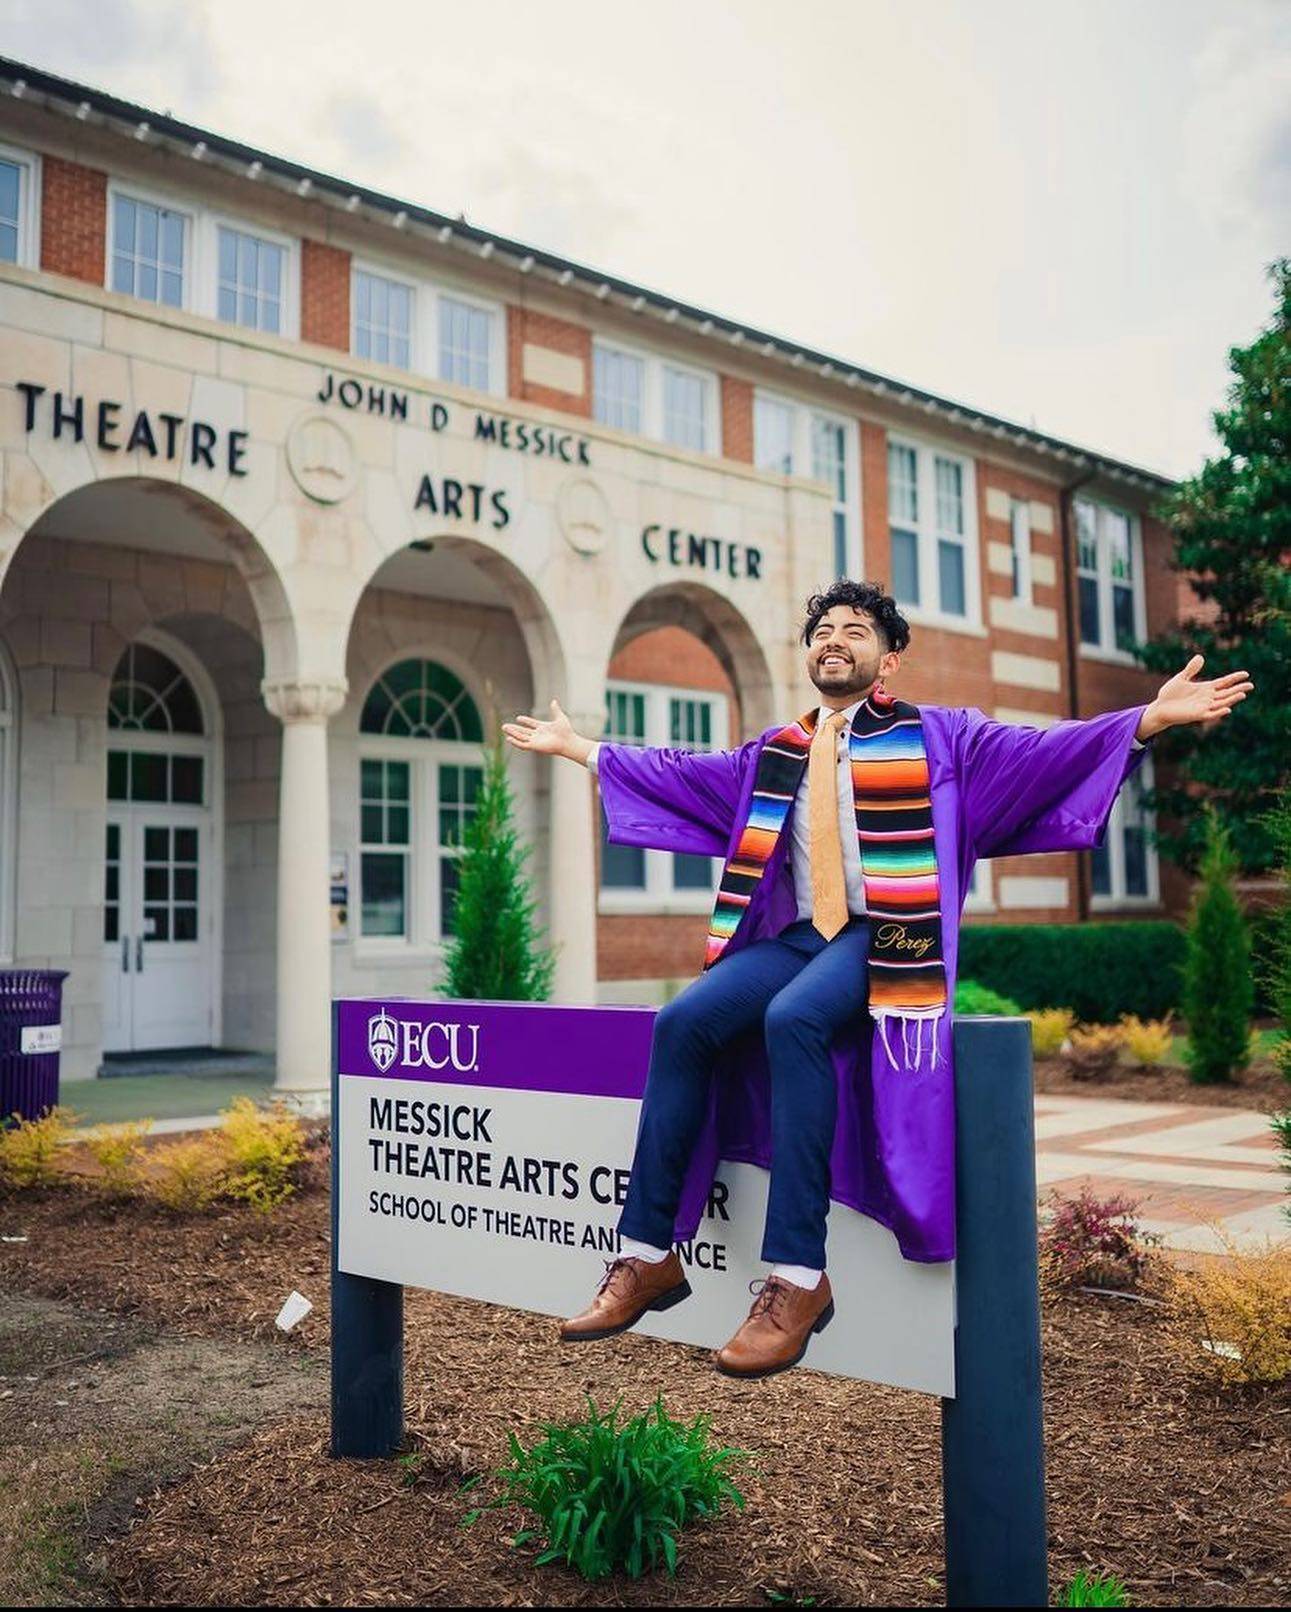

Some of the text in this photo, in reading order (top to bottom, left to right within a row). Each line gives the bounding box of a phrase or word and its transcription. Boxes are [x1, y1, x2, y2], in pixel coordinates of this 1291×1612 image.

[318, 374, 591, 466] JOHN D MESSICK
[16, 382, 762, 580] THEATRE ARTS CENTER
[874, 923, 936, 958] Perez
[370, 1097, 493, 1144] MESSICK
[369, 1138, 731, 1222] THEATRE ARTS CER
[369, 1190, 728, 1272] SCHOOL OF THEATRE AN NCE
